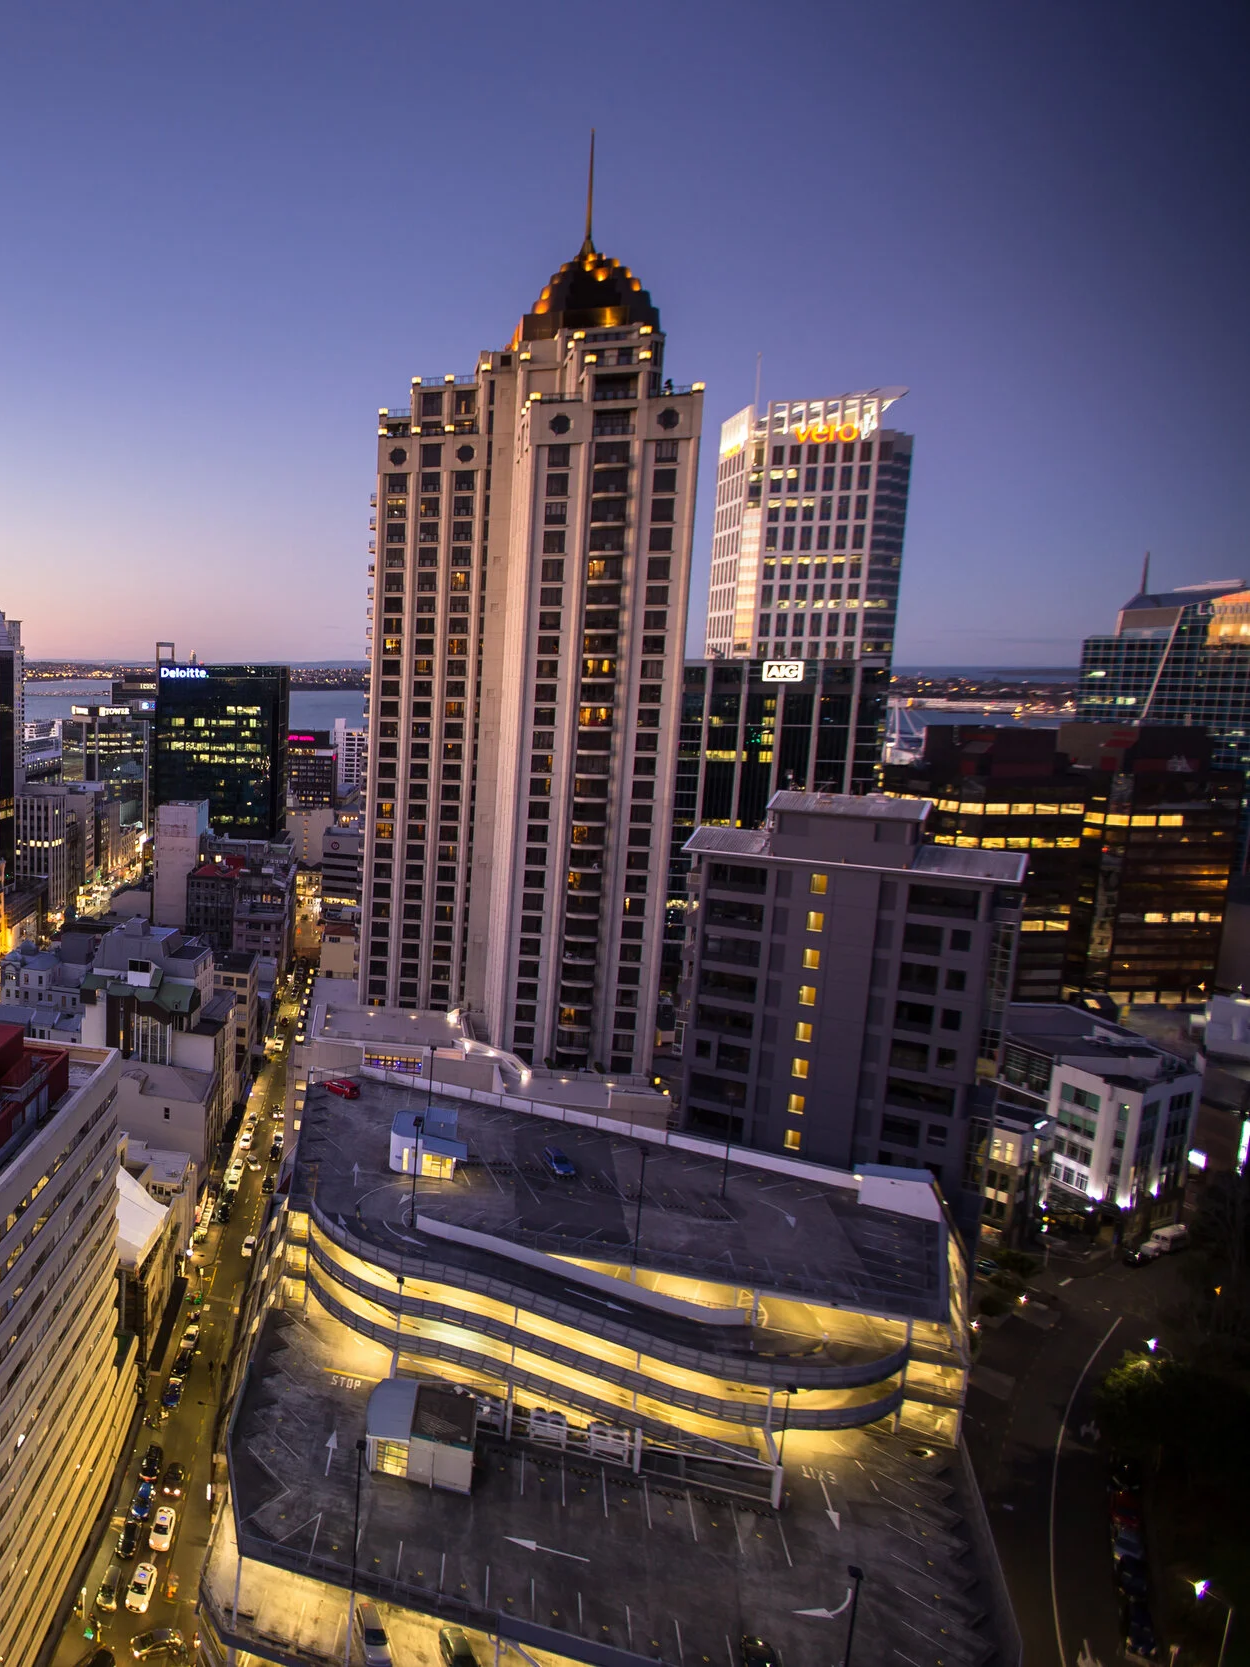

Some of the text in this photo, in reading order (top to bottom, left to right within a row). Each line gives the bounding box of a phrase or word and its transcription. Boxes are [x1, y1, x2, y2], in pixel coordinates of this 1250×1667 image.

[795, 422, 860, 443] vero
[767, 664, 799, 678] AIG
[330, 1374, 362, 1390] STOP
